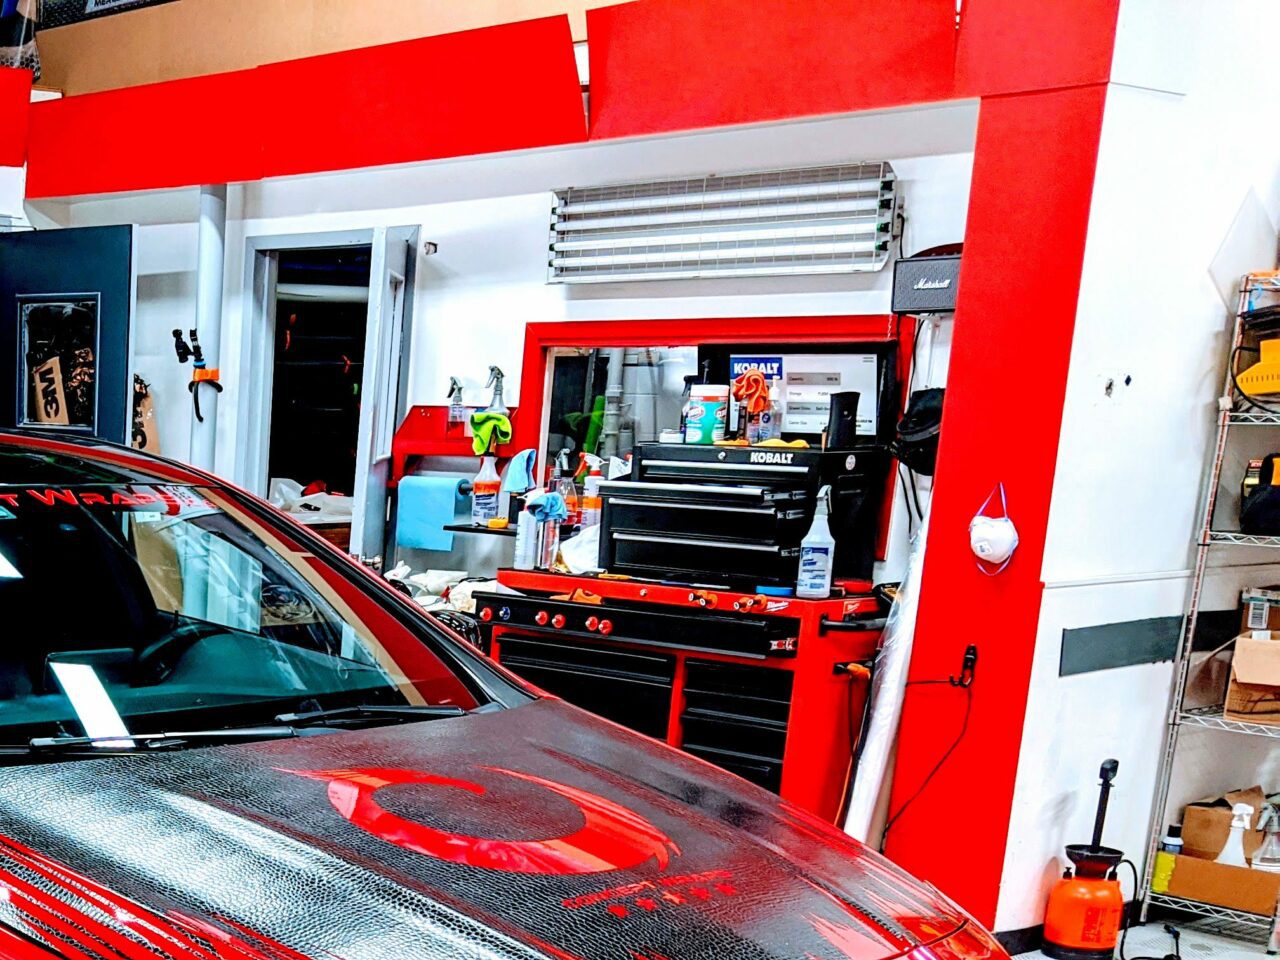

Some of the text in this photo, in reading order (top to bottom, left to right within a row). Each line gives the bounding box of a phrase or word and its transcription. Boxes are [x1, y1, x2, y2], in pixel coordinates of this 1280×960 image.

[913, 276, 951, 290] Marshall
[38, 366, 61, 419] 3M
[750, 451, 794, 465] KOBALT
